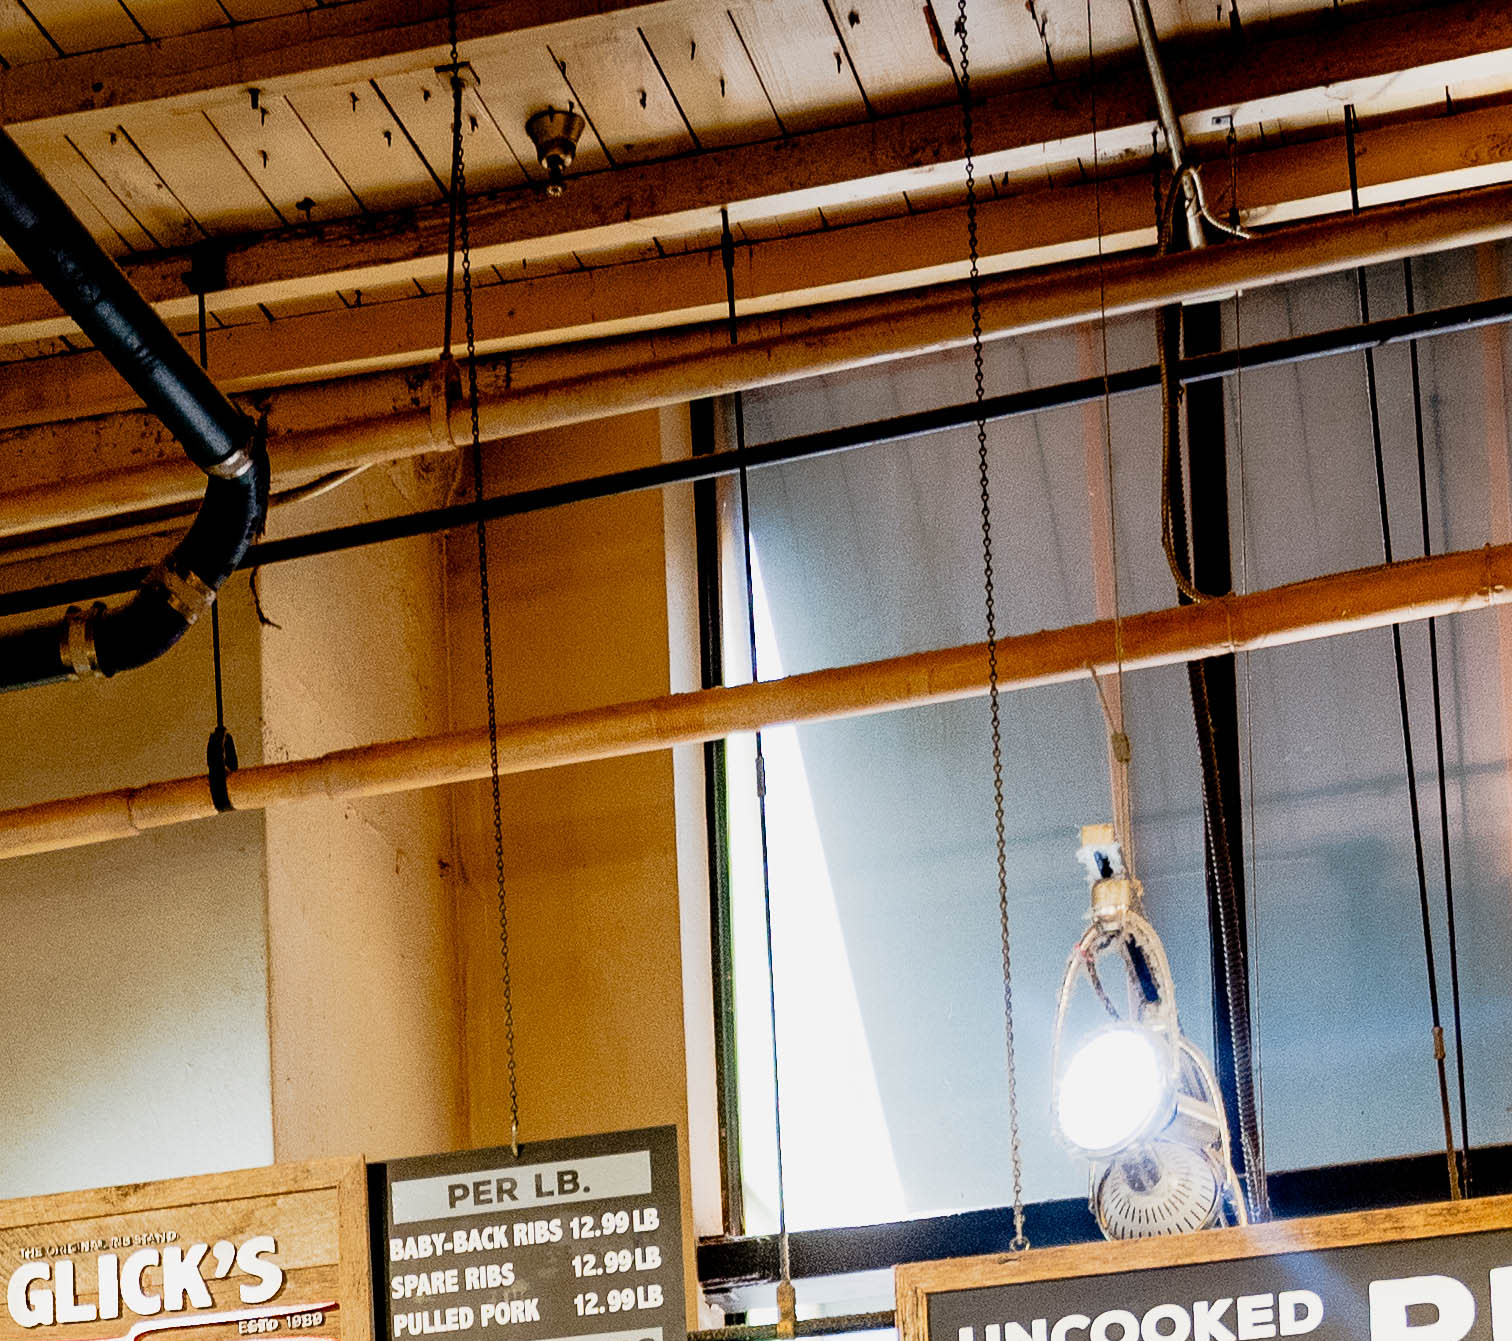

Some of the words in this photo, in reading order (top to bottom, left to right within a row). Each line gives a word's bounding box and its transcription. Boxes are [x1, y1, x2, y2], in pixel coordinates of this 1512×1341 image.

[448, 1177, 520, 1210] PER
[536, 1169, 592, 1200] LB.
[20, 1247, 44, 1259] THE
[132, 1231, 178, 1246] STAND
[389, 1225, 508, 1261] BABY-BACK
[514, 1219, 563, 1248] RIBS
[570, 1210, 630, 1240] 12.99
[633, 1208, 660, 1233] LB
[7, 1236, 286, 1327] GLICK'S
[391, 1267, 466, 1299] SPARE
[473, 1262, 515, 1289] RIBS
[572, 1249, 632, 1278] 12.99
[634, 1245, 662, 1271] LB
[393, 1306, 473, 1338] PULLED
[481, 1297, 540, 1325] PORK
[574, 1287, 636, 1317] 12.99
[638, 1285, 665, 1309] LB
